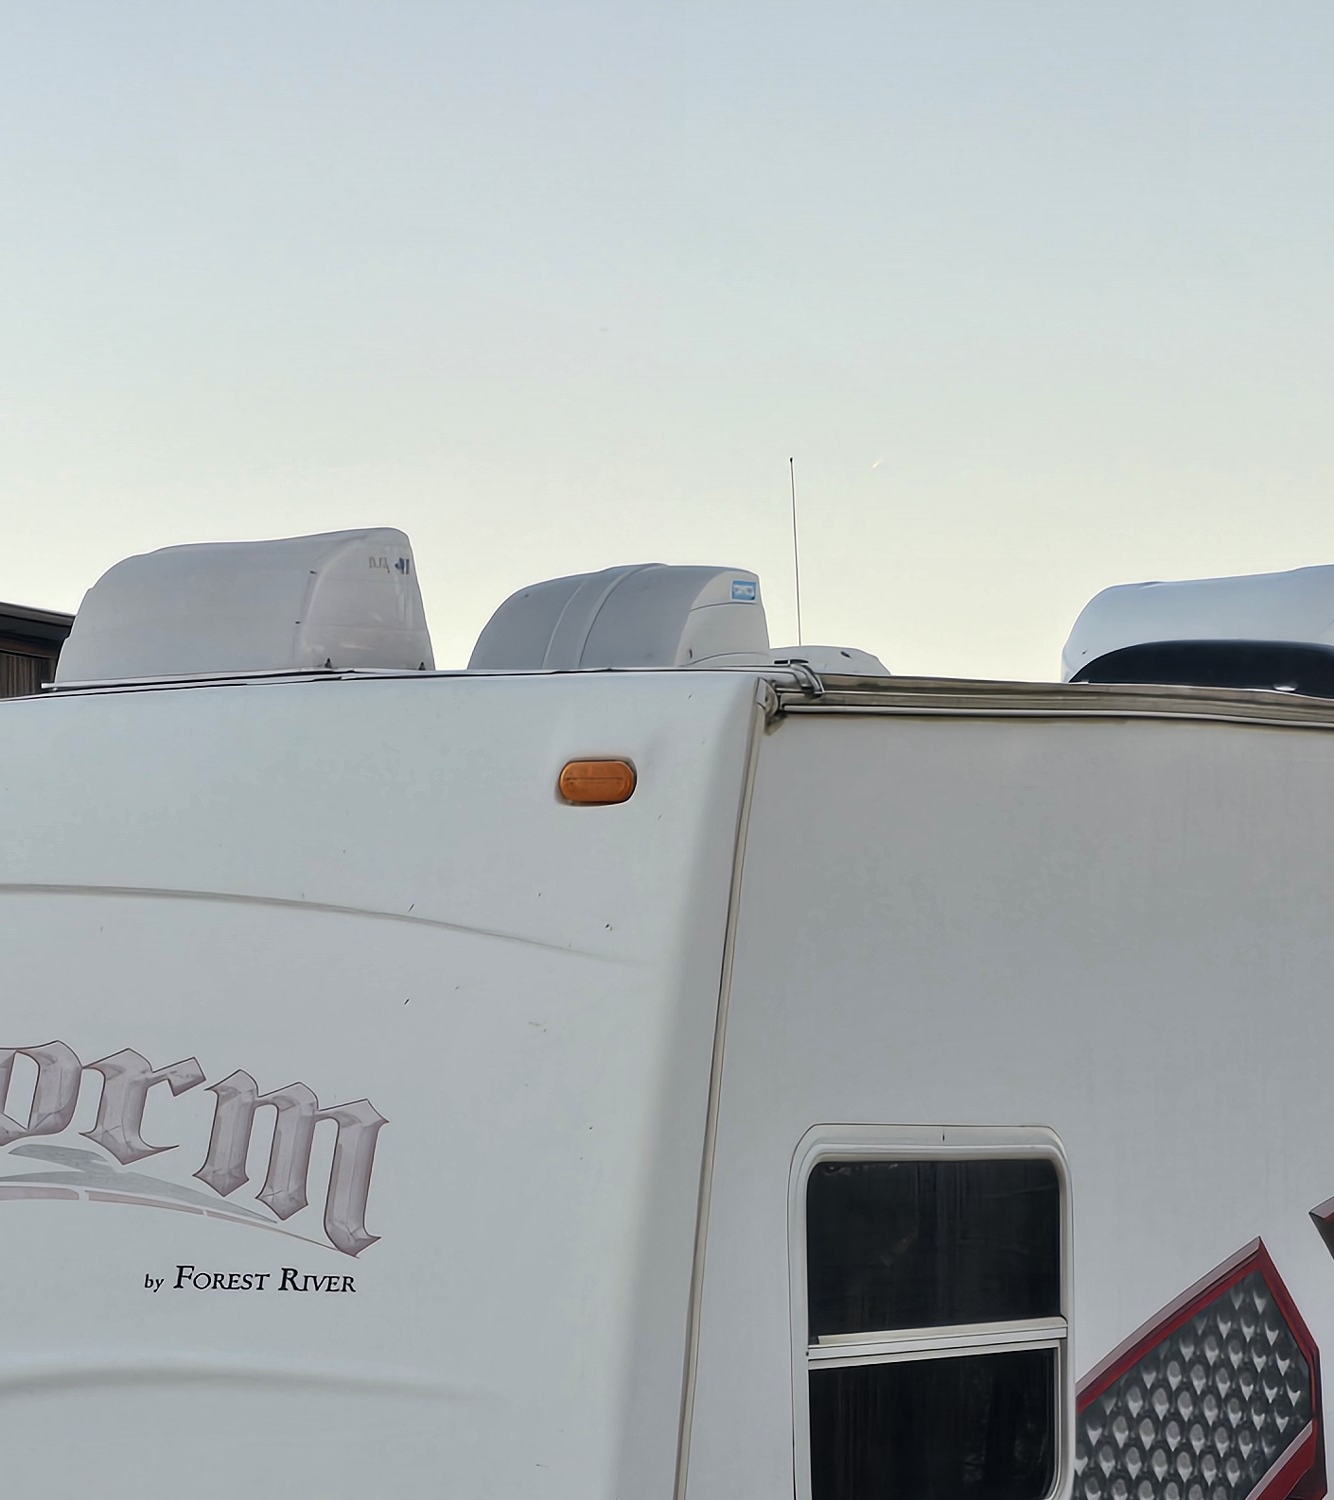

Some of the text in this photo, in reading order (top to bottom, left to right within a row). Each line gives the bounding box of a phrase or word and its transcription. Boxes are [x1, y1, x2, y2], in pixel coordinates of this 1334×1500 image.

[144, 1265, 357, 1293] by FOREST RIVER
